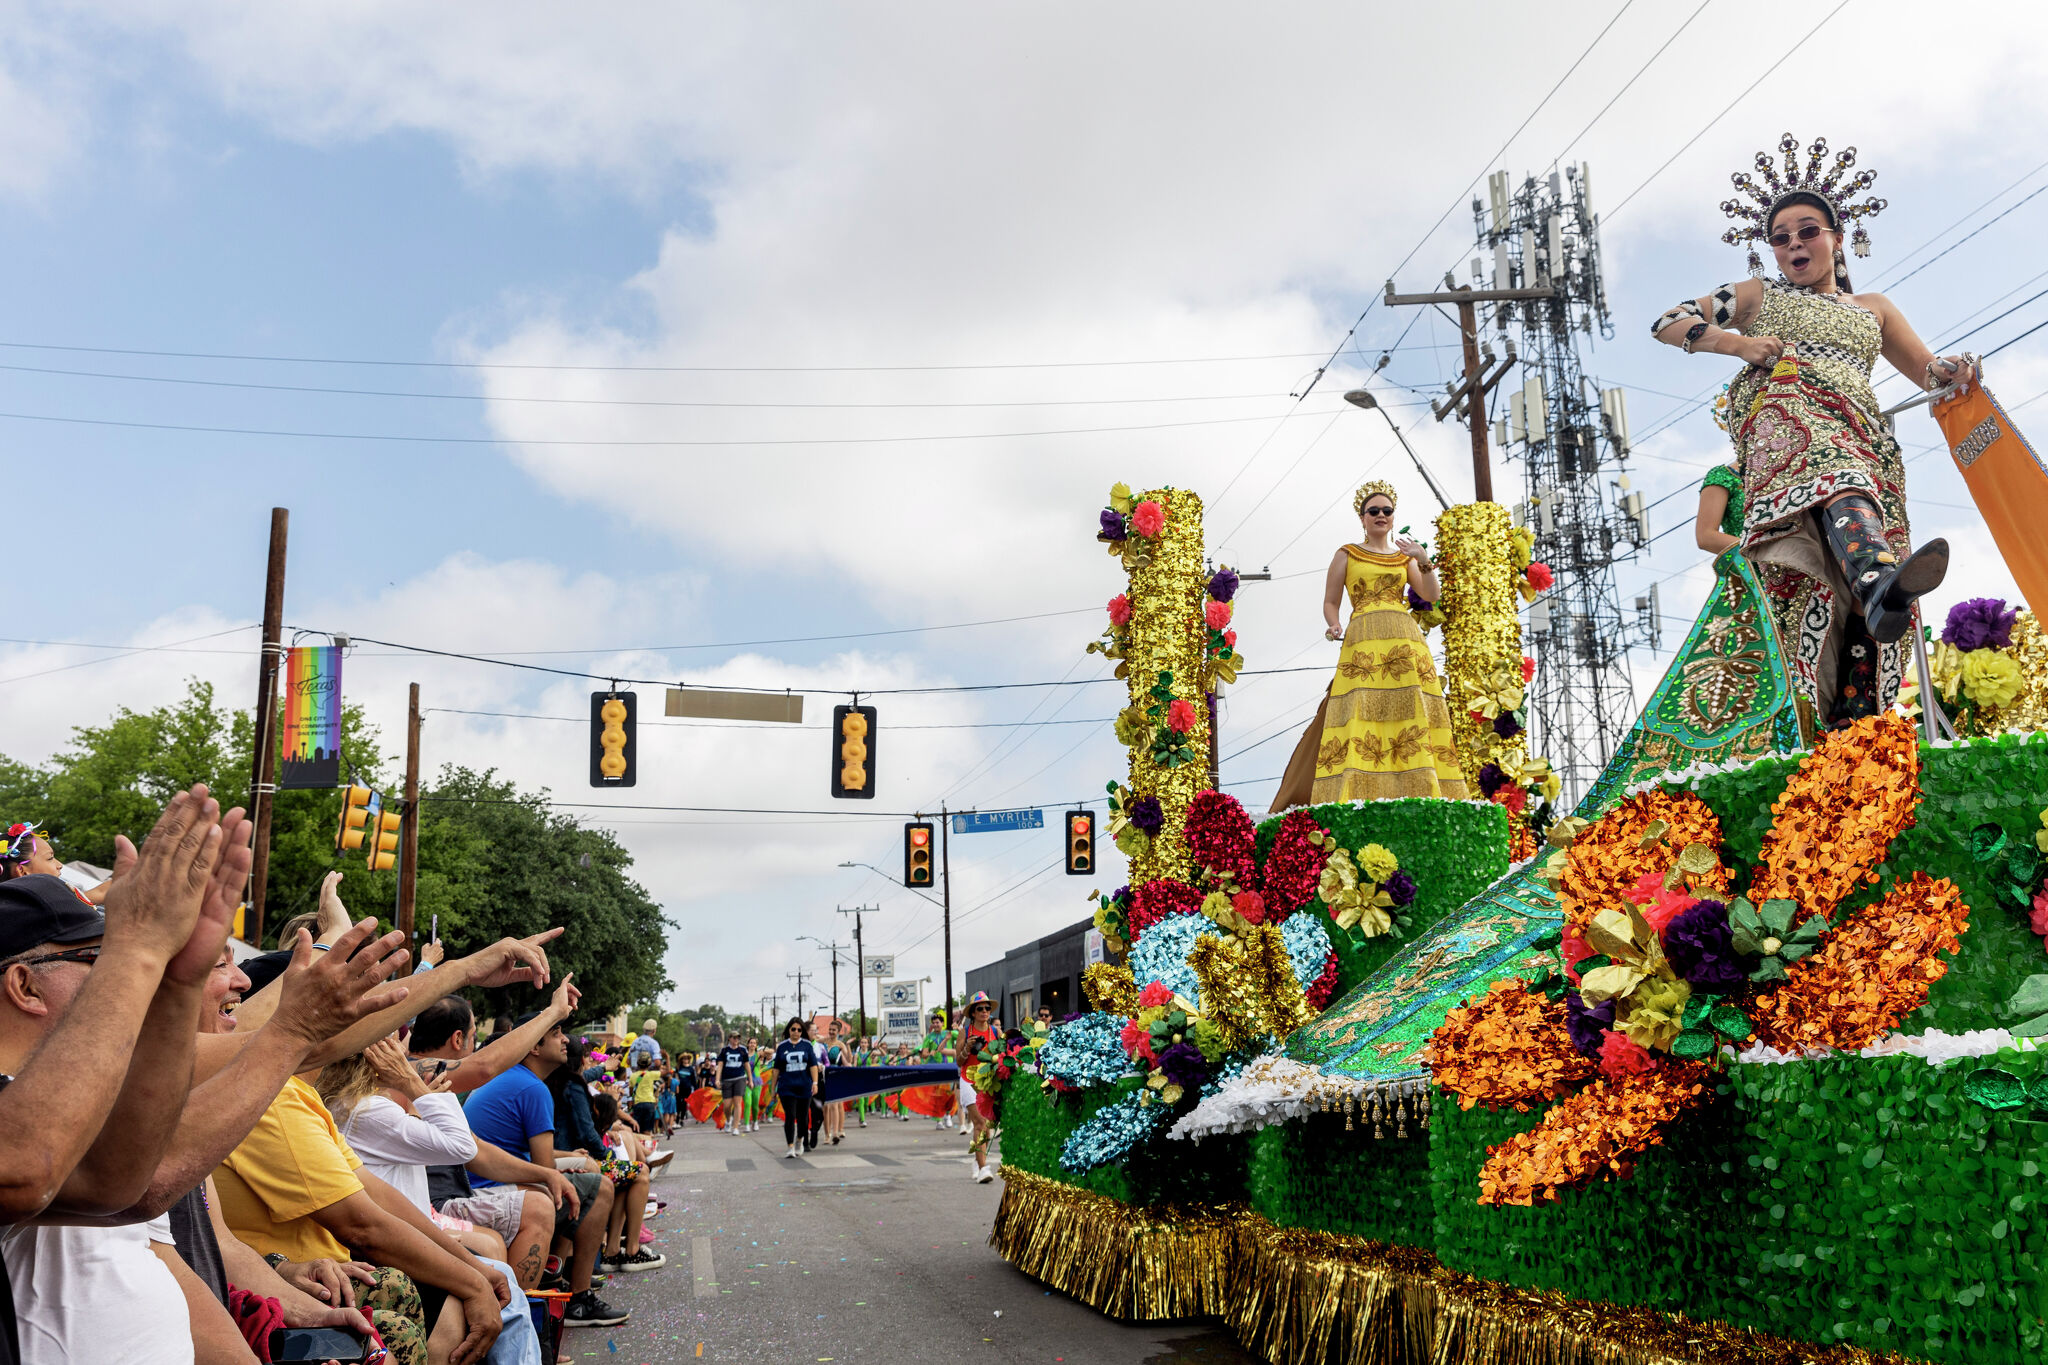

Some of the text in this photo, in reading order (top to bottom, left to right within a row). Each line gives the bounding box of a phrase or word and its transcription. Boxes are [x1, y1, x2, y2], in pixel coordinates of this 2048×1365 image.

[296, 672, 335, 696] Texas
[975, 812, 1035, 825] E MYRTLE
[1017, 821, 1033, 830] 100
[888, 1018, 919, 1028] FURNITURE
